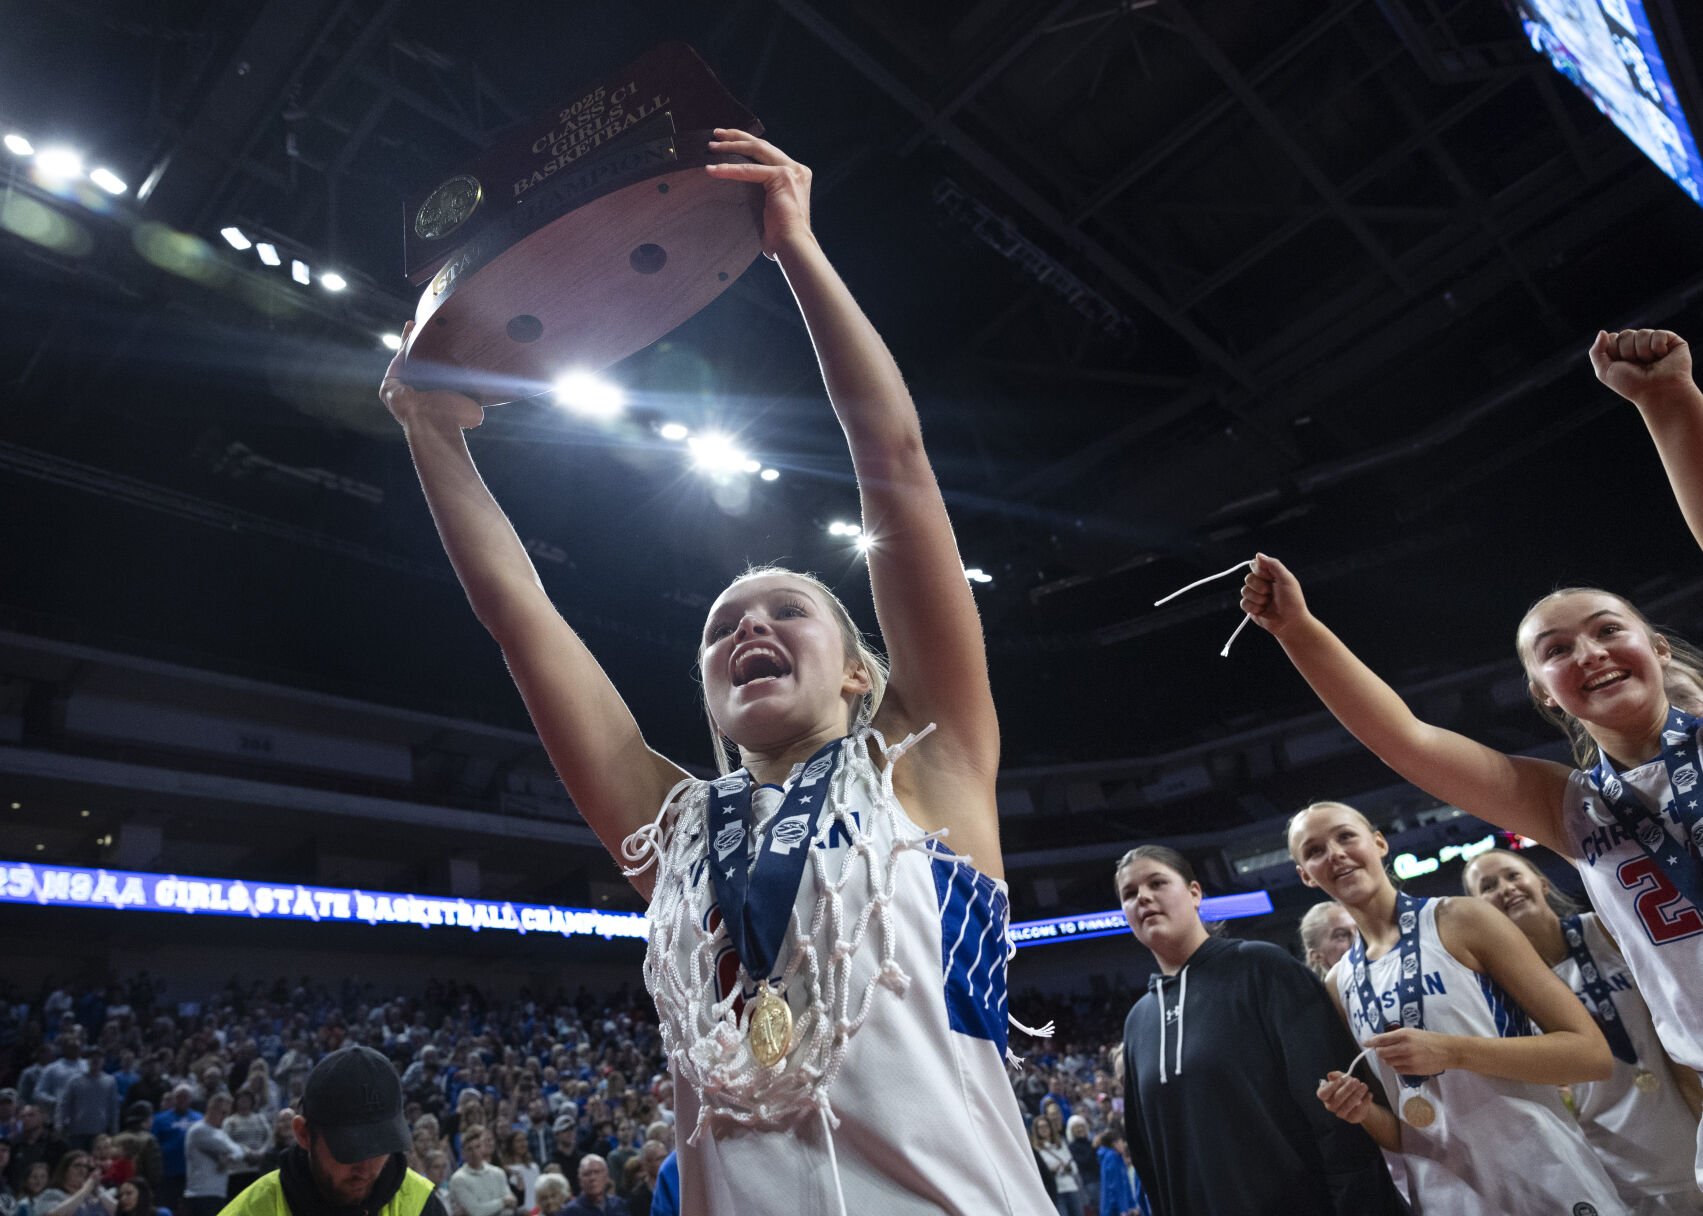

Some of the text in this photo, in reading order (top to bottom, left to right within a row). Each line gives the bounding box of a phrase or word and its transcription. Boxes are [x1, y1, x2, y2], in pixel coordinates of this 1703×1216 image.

[532, 81, 639, 154] CLASS C1
[551, 103, 624, 156] GIRLS
[559, 85, 606, 124] 2025
[513, 94, 671, 197] BASKETBALL
[43, 870, 147, 905] NSAA
[155, 879, 249, 911] GIRLS
[254, 887, 350, 919] STATE
[356, 895, 519, 930] BASKETBALL
[1009, 915, 1128, 941] ELCOME TO PINNACL
